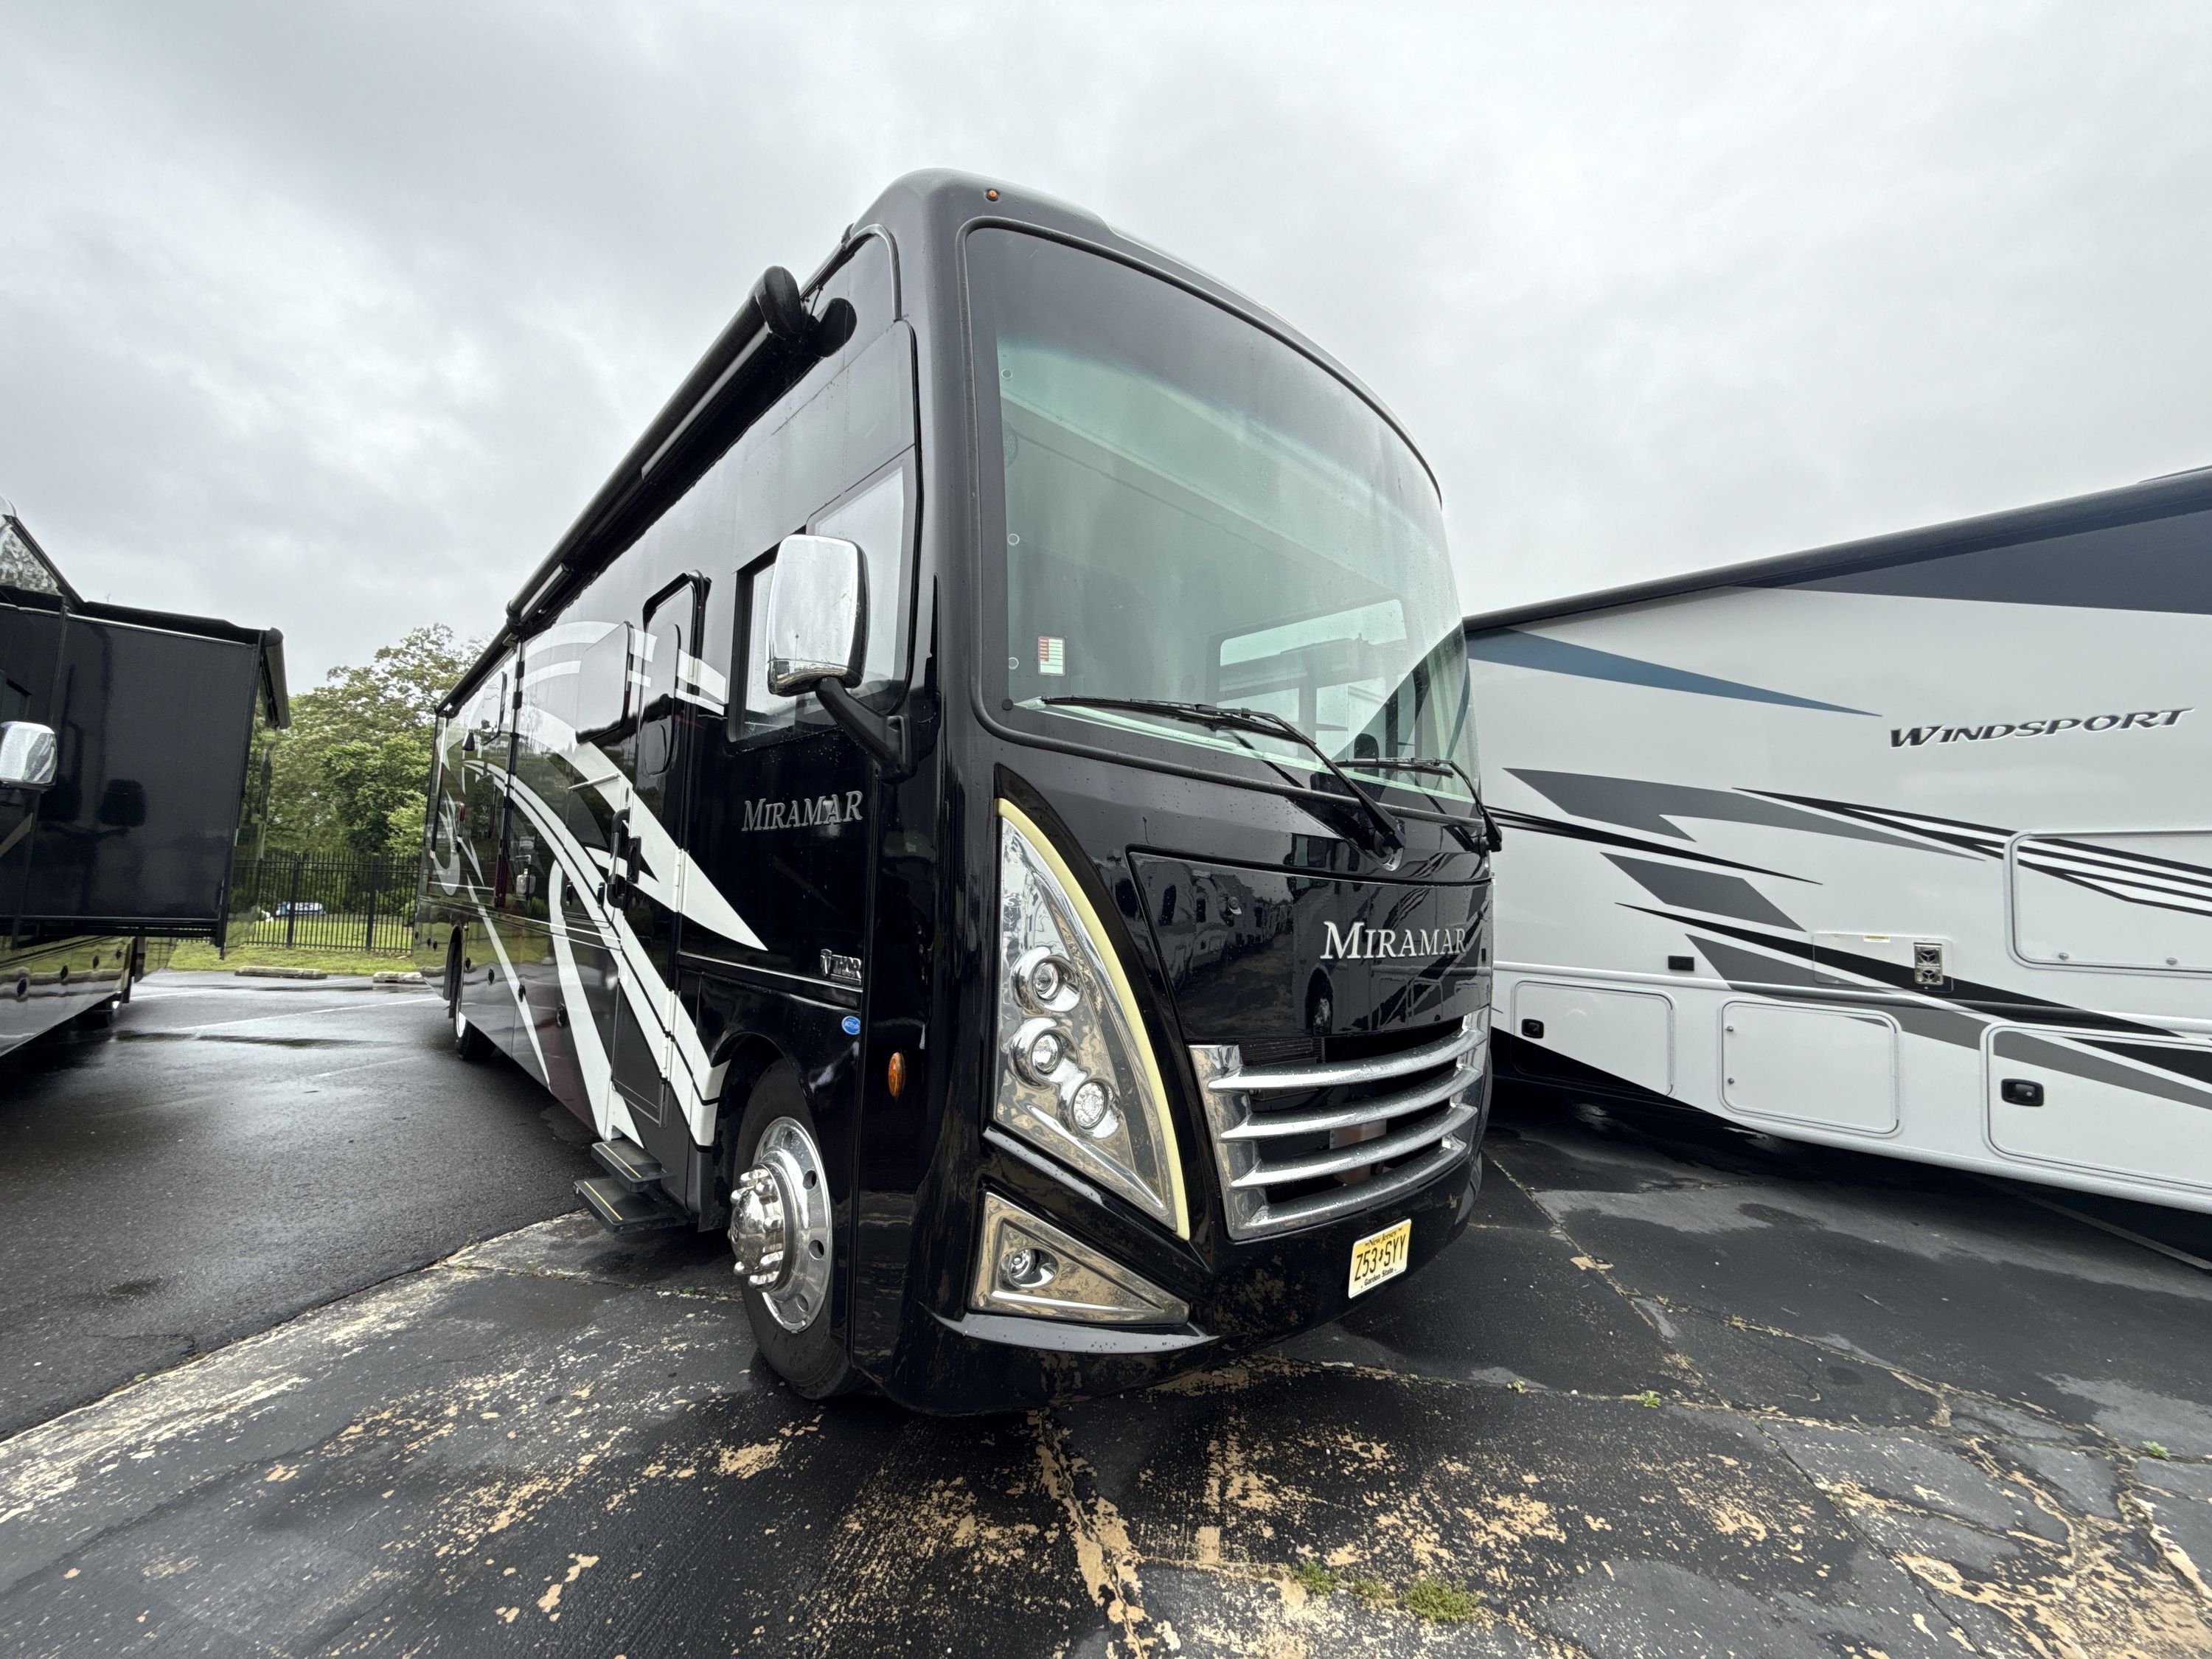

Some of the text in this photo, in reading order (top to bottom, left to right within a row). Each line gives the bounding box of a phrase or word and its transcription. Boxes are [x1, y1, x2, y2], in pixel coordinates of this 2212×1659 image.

[1889, 707, 2195, 748] WINDSPORT
[741, 790, 863, 832] MIRAMAR
[1320, 921, 1467, 959] MIRAMAR
[1368, 1230, 1397, 1247] New Jersey
[1364, 1267, 1394, 1287] Garden State
